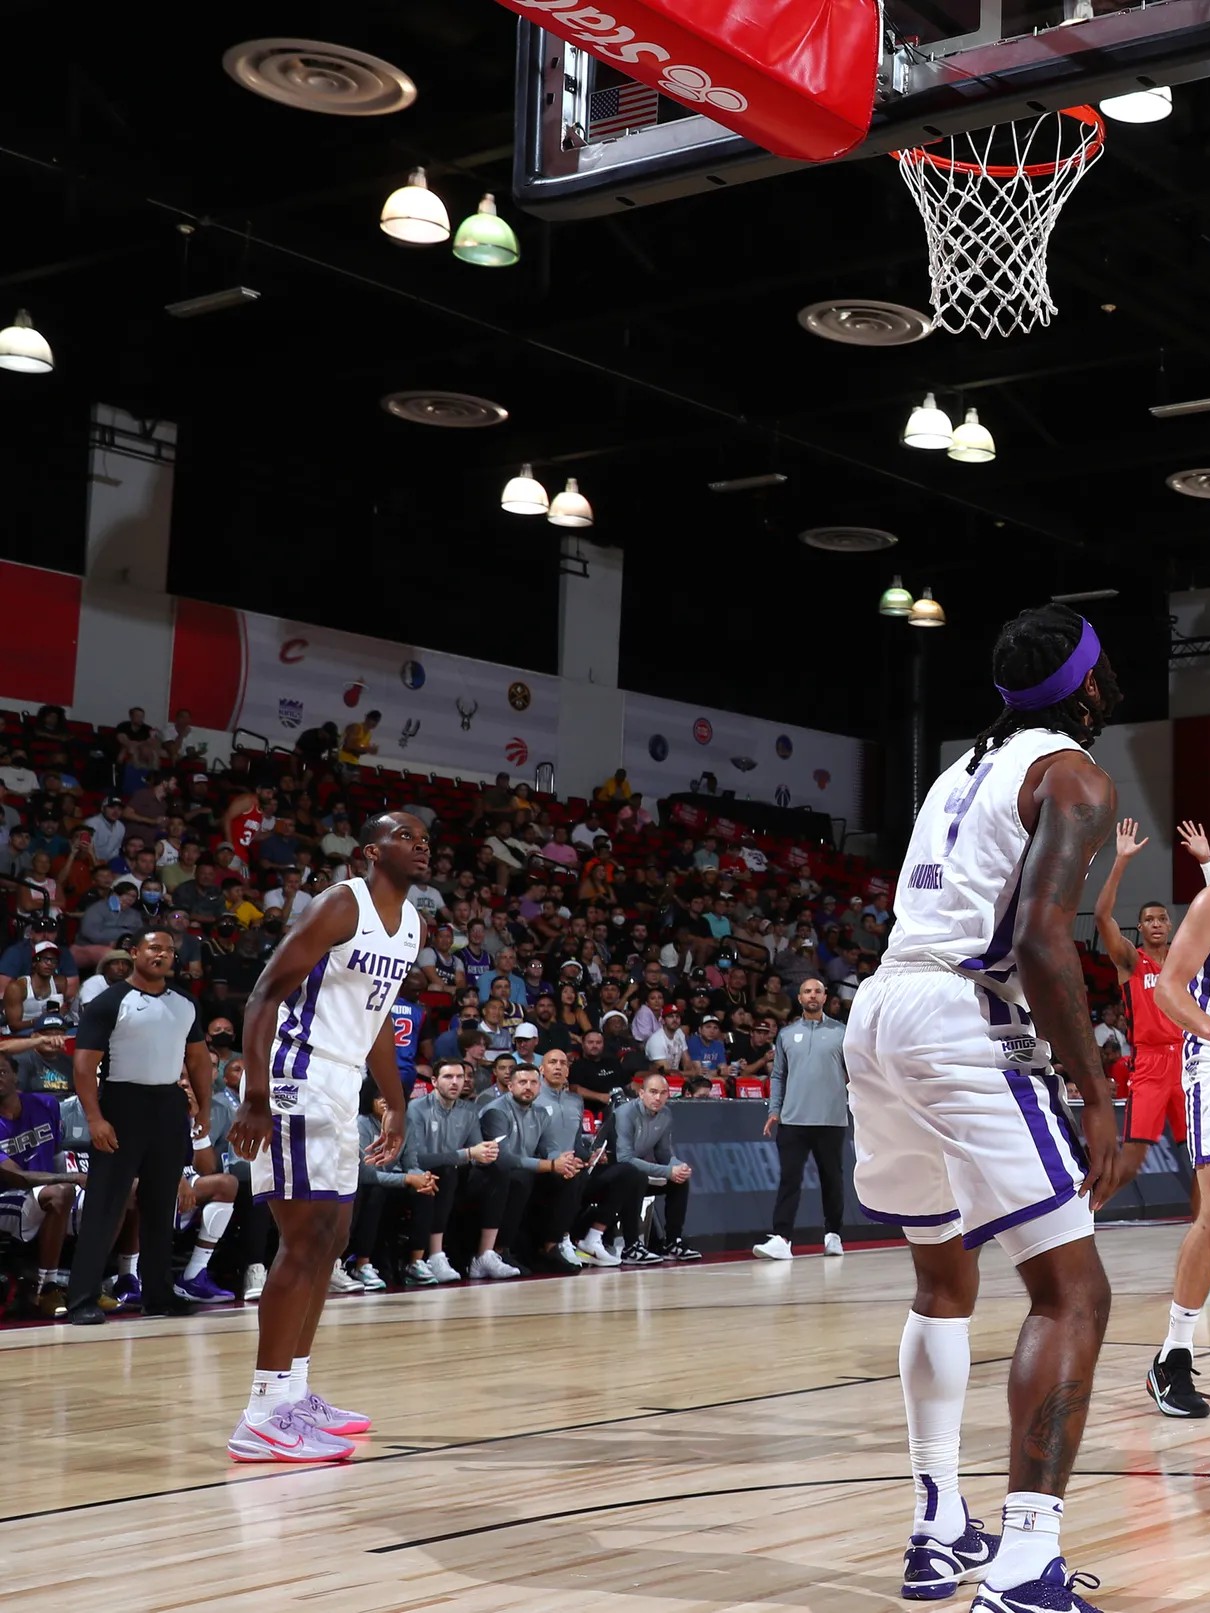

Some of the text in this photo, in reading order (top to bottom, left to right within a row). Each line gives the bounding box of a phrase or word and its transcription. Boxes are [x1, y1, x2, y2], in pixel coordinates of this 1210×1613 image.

[513, 0, 671, 63] Sta
[365, 980, 392, 1011] 23
[1001, 1039, 1036, 1052] KINGS
